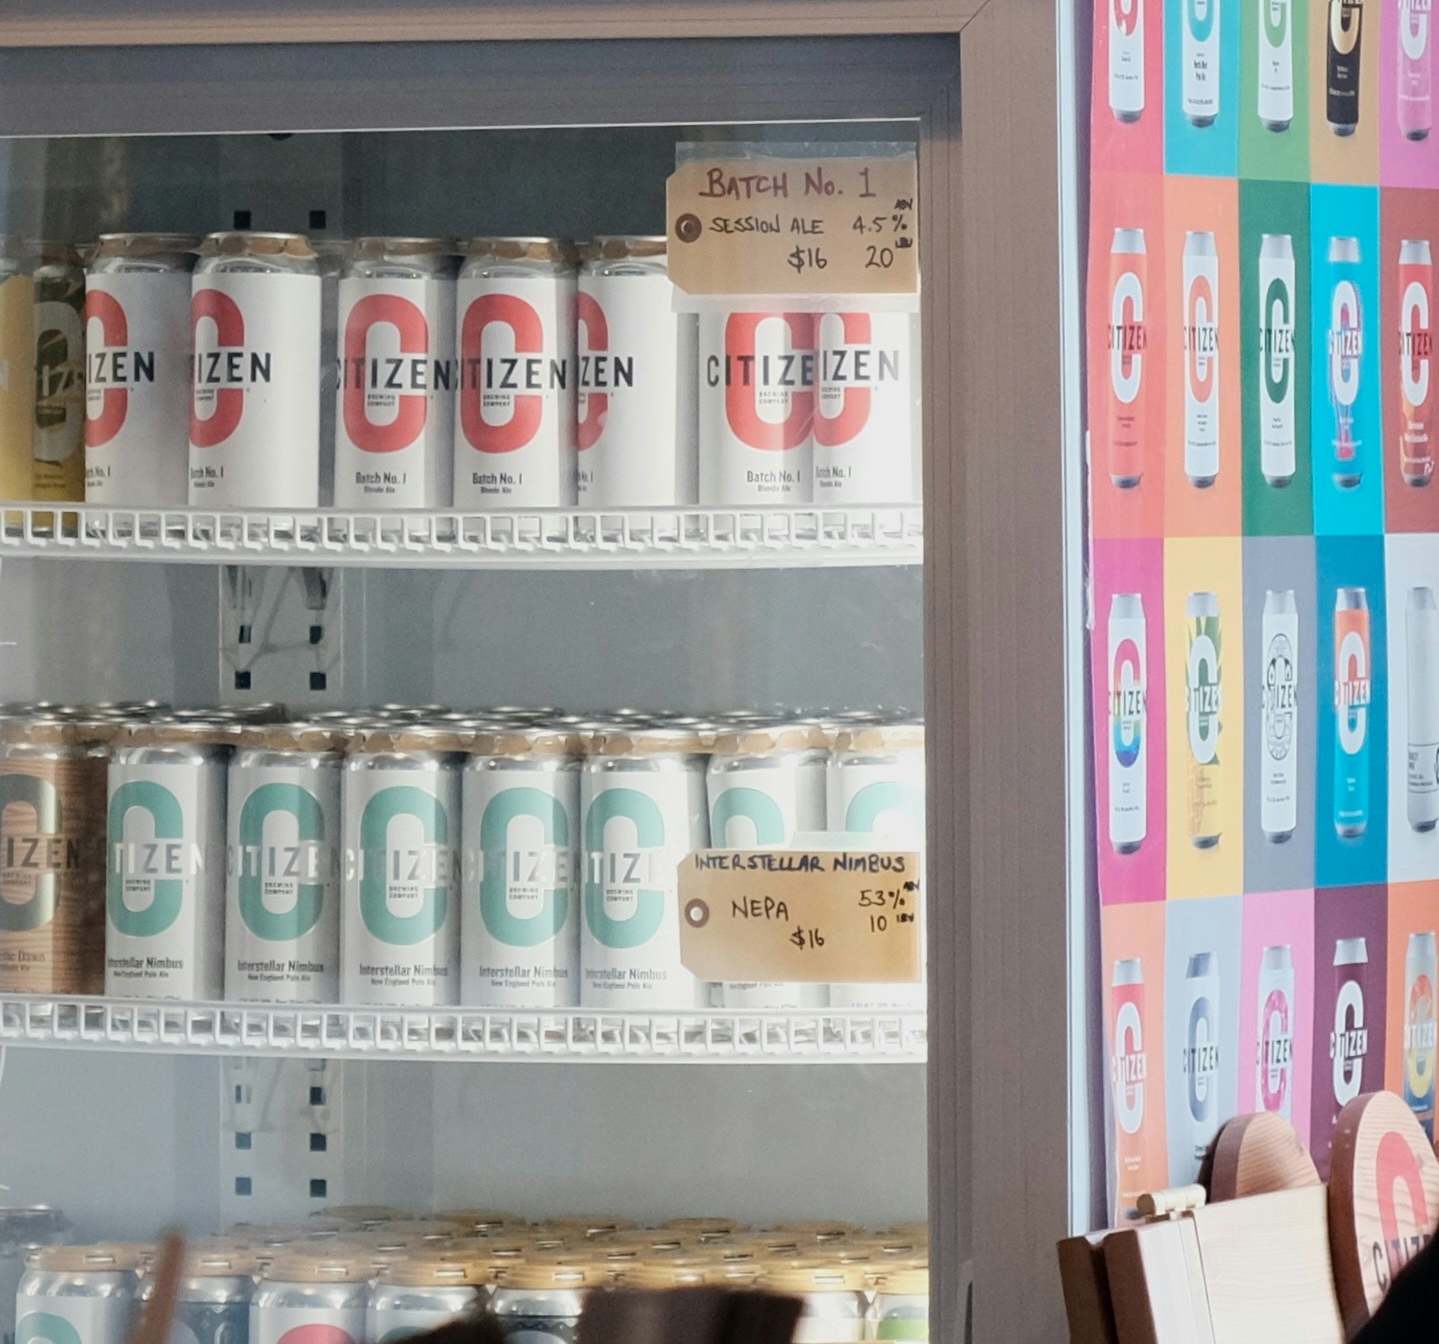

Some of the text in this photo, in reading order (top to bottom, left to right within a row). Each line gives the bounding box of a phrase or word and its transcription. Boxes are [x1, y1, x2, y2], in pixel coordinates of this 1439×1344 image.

[698, 166, 877, 200] BATCH No. 1
[709, 213, 781, 234] SESSION
[790, 216, 824, 234] ALE
[787, 245, 894, 274] $16 20
[189, 352, 272, 384] IZEN
[355, 472, 381, 485] Batch
[746, 470, 776, 483] Batch
[695, 852, 906, 873] INTERSTELLAR NIMBUS
[731, 896, 789, 921] NEPA
[870, 915, 887, 933] 10
[789, 925, 825, 950] $16
[237, 960, 285, 973] Interstellar
[359, 964, 410, 977] Interstellar
[479, 965, 531, 978] Interstellar
